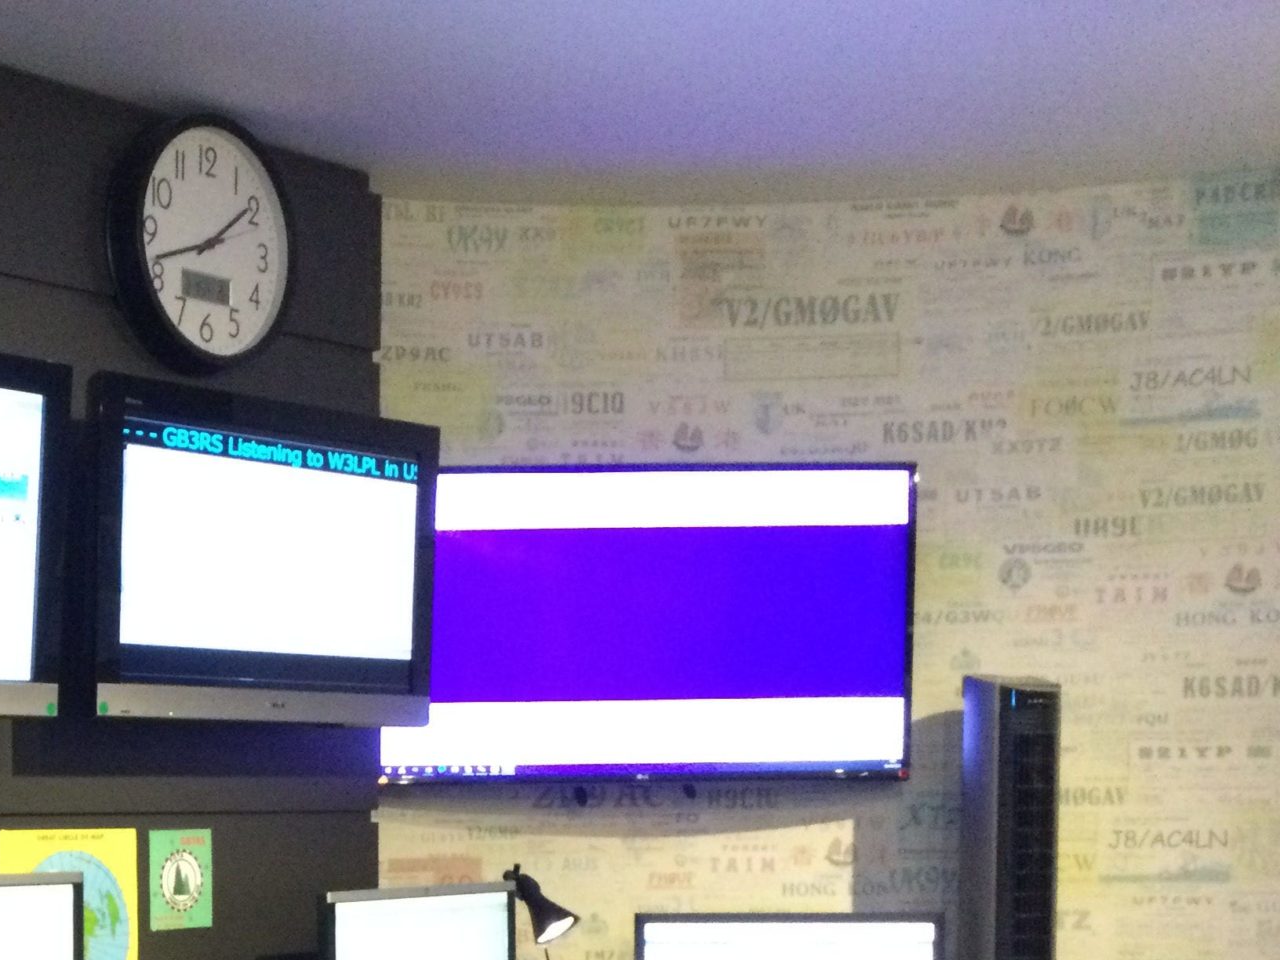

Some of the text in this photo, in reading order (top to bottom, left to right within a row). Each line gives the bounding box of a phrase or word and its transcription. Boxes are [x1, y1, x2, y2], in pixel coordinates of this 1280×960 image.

[175, 149, 185, 181] 11
[199, 144, 218, 178] 12
[152, 176, 172, 210] 10
[247, 195, 259, 226] 2
[144, 215, 157, 245] 9
[257, 243, 268, 273] 3
[151, 261, 164, 292] 8
[175, 296, 187, 326] 7
[249, 282, 260, 311] 4
[199, 313, 213, 343] 6
[228, 308, 240, 338] 5
[162, 426, 223, 453] GB3RS
[228, 436, 302, 469] Listening
[306, 449, 324, 468] to
[327, 451, 381, 477] W3LPL
[384, 459, 399, 479] in
